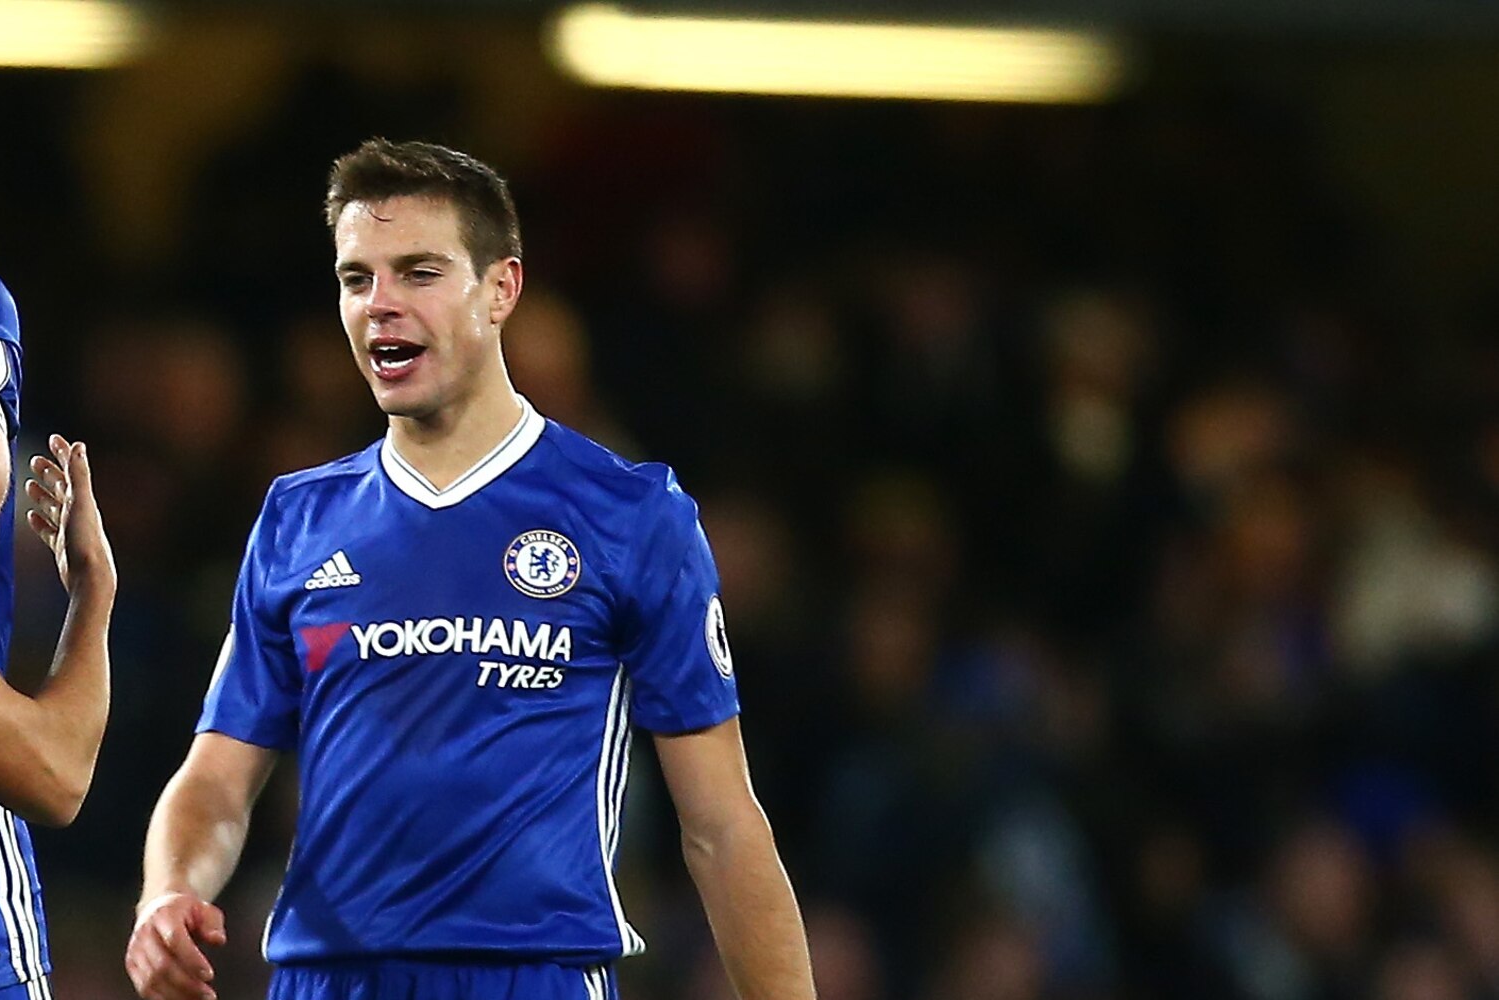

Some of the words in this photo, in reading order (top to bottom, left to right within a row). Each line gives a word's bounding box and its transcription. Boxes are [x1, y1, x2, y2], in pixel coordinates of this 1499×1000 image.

[520, 533, 569, 551] CHELSEA
[304, 573, 361, 590] adidas
[351, 617, 571, 662] YOKOHAMA
[477, 661, 565, 688] TYRES
